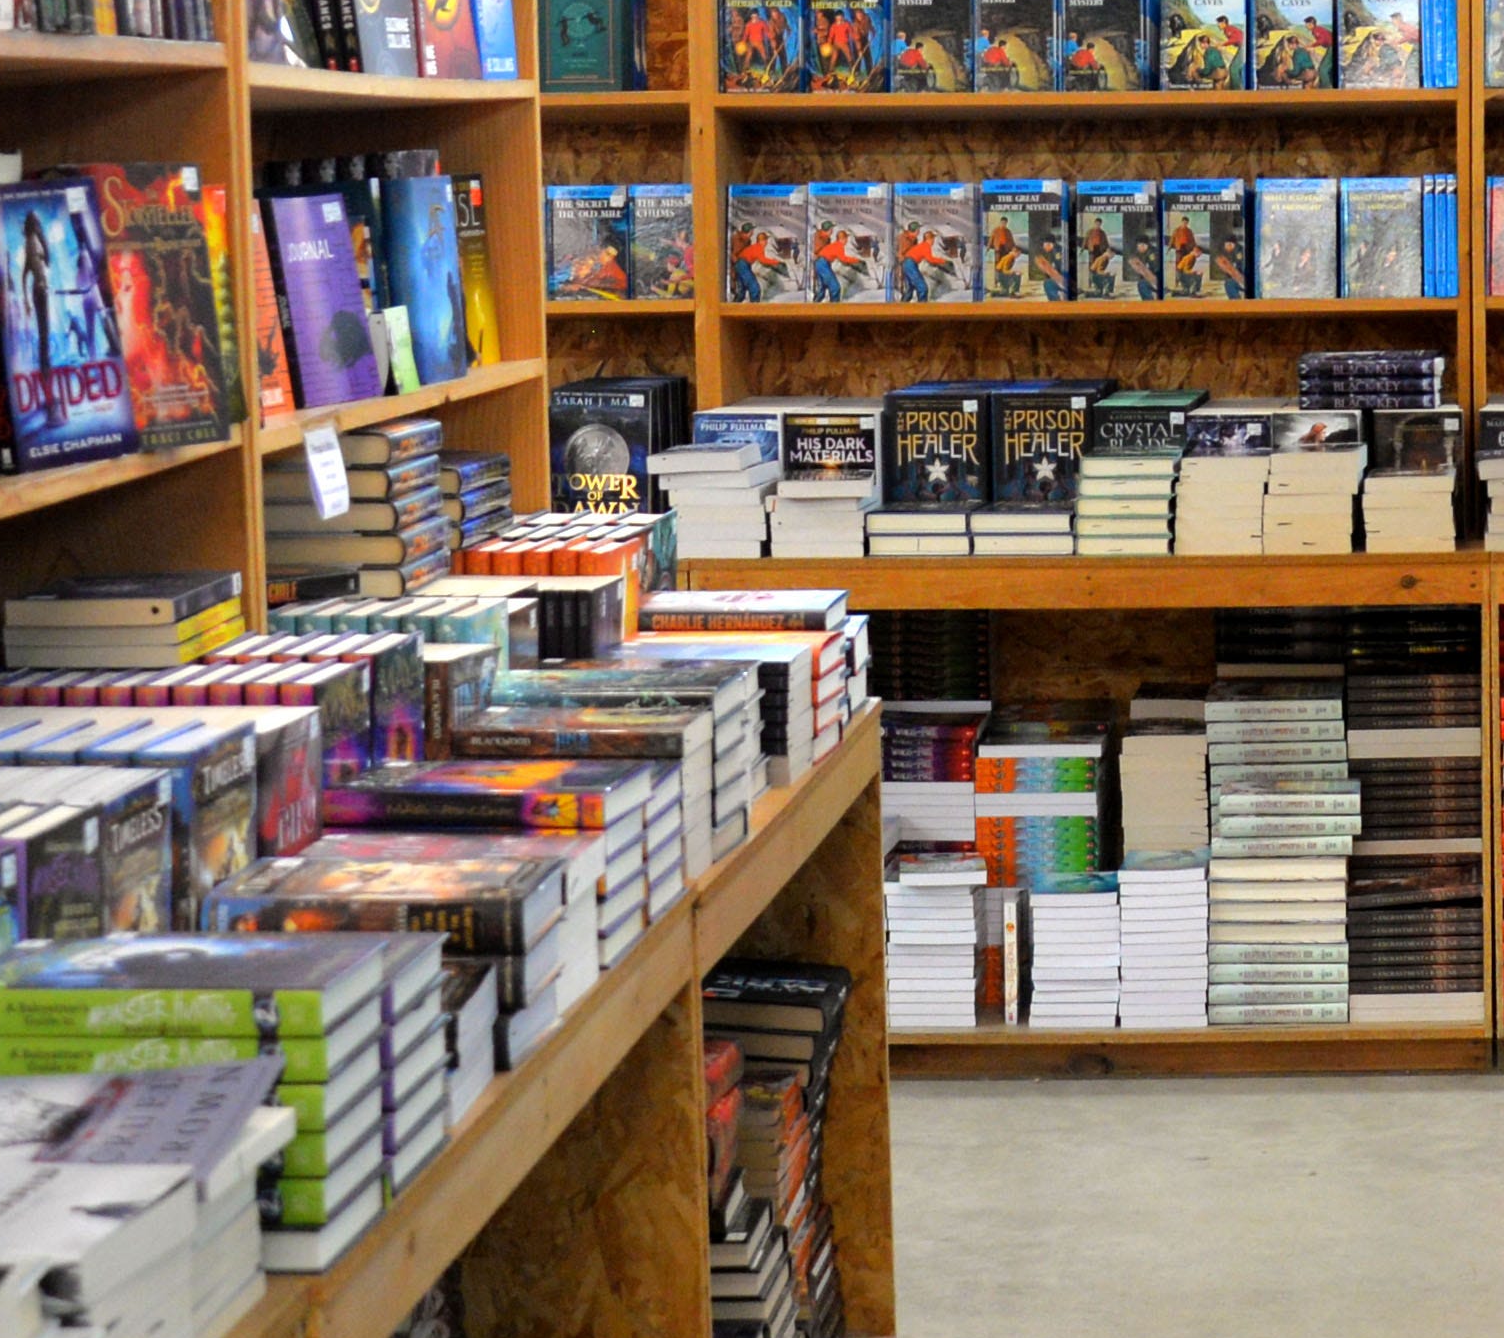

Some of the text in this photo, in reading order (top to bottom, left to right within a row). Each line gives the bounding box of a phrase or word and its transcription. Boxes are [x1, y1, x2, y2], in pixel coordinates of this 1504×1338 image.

[997, 194, 1040, 202] THE GREAT
[1092, 195, 1108, 204] THE
[1179, 194, 1195, 202] THE
[555, 200, 608, 208] THE SECRET
[989, 203, 1060, 213] AIRPORT MYSTERY
[1084, 204, 1155, 213] AIRPORT MYSTERY
[1171, 203, 1241, 212] AIRPORT MYSTERY
[558, 210, 575, 219] THE
[578, 210, 598, 219] OLD
[286, 238, 335, 263] JOURNAL
[1333, 363, 1400, 374] BLACK KEY
[14, 360, 123, 421] DIVIDED
[1333, 380, 1400, 391] BLACK KEY
[556, 396, 592, 407] SARAH
[610, 396, 630, 407] MA
[1334, 397, 1401, 408] BLACK KEY
[906, 411, 978, 433] PRISON
[1013, 410, 1085, 431] PRISON
[700, 422, 728, 431] PHILIP
[1100, 421, 1181, 439] CRYSTAL
[28, 432, 123, 458] ELSIE CHAPMAN
[797, 437, 866, 450] HIS DARK
[1004, 431, 1085, 465] HEALER
[897, 433, 980, 466] HEALER
[790, 449, 874, 463] MATERIALS
[553, 472, 639, 500] TOWER
[586, 490, 604, 501] OF
[651, 613, 705, 631] CHARLIE
[110, 806, 163, 853] TIMELESS
